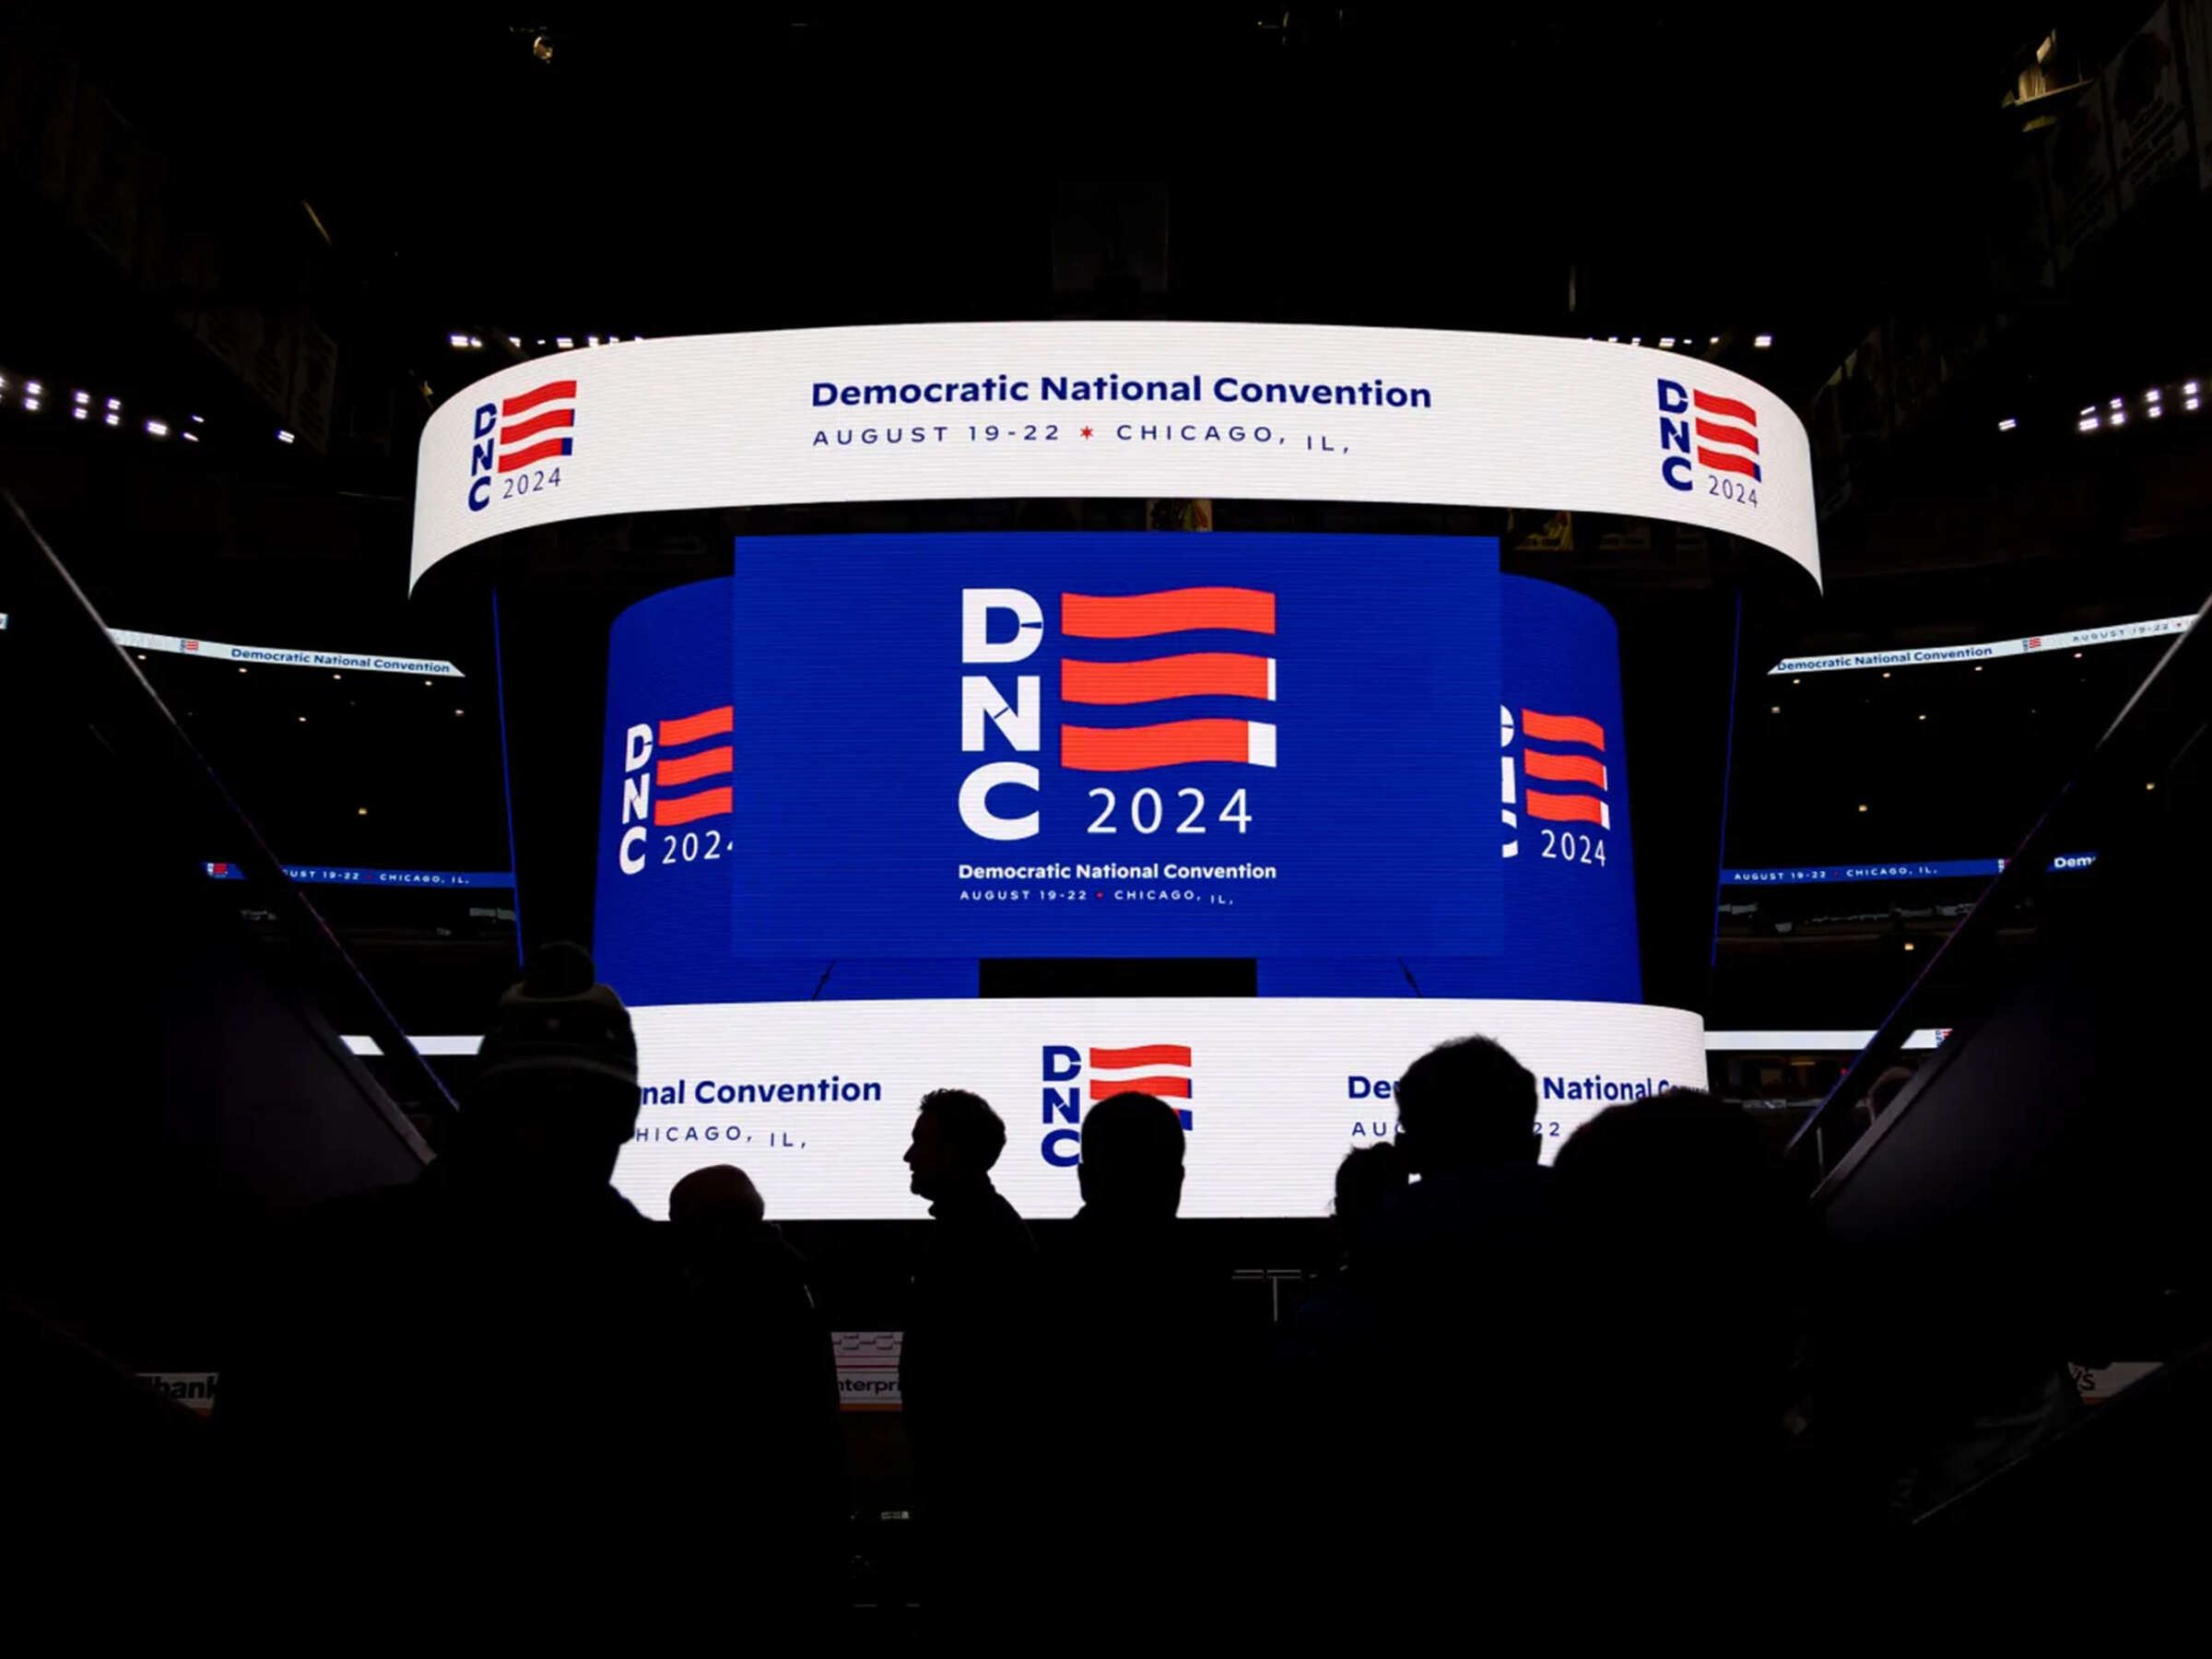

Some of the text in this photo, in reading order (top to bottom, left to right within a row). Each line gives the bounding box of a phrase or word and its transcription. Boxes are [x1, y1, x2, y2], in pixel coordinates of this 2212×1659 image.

[813, 373, 1431, 409] Democratic National Convention
[813, 425, 1349, 454] AUGUST 19-22 CHICAGO, IL,
[1657, 379, 1693, 491] DNC
[468, 403, 497, 512] DNC
[502, 466, 561, 500] 2024
[1708, 475, 1759, 508] 2024
[2073, 629, 2124, 641] AUGUST
[231, 648, 450, 674] Democratic National Convention
[1777, 647, 1993, 671] Democratic National Convention
[959, 589, 1043, 840] DNC
[619, 724, 653, 875] DNC
[1088, 788, 1252, 833] 2024
[662, 830, 733, 864] 202
[1541, 830, 1606, 867] 2024
[2053, 854, 2097, 869] Dem
[959, 863, 1277, 879] Democratic National Convention
[1734, 870, 1783, 881] AUGUST
[1791, 869, 1827, 879] 19-22
[959, 889, 1030, 900] AUGUST
[1041, 889, 1087, 900] 19-22
[640, 1076, 882, 1104] nal Convention
[1544, 1076, 1653, 1100] National
[1041, 1045, 1082, 1168] DNC
[636, 1126, 752, 1142] HICAGO,
